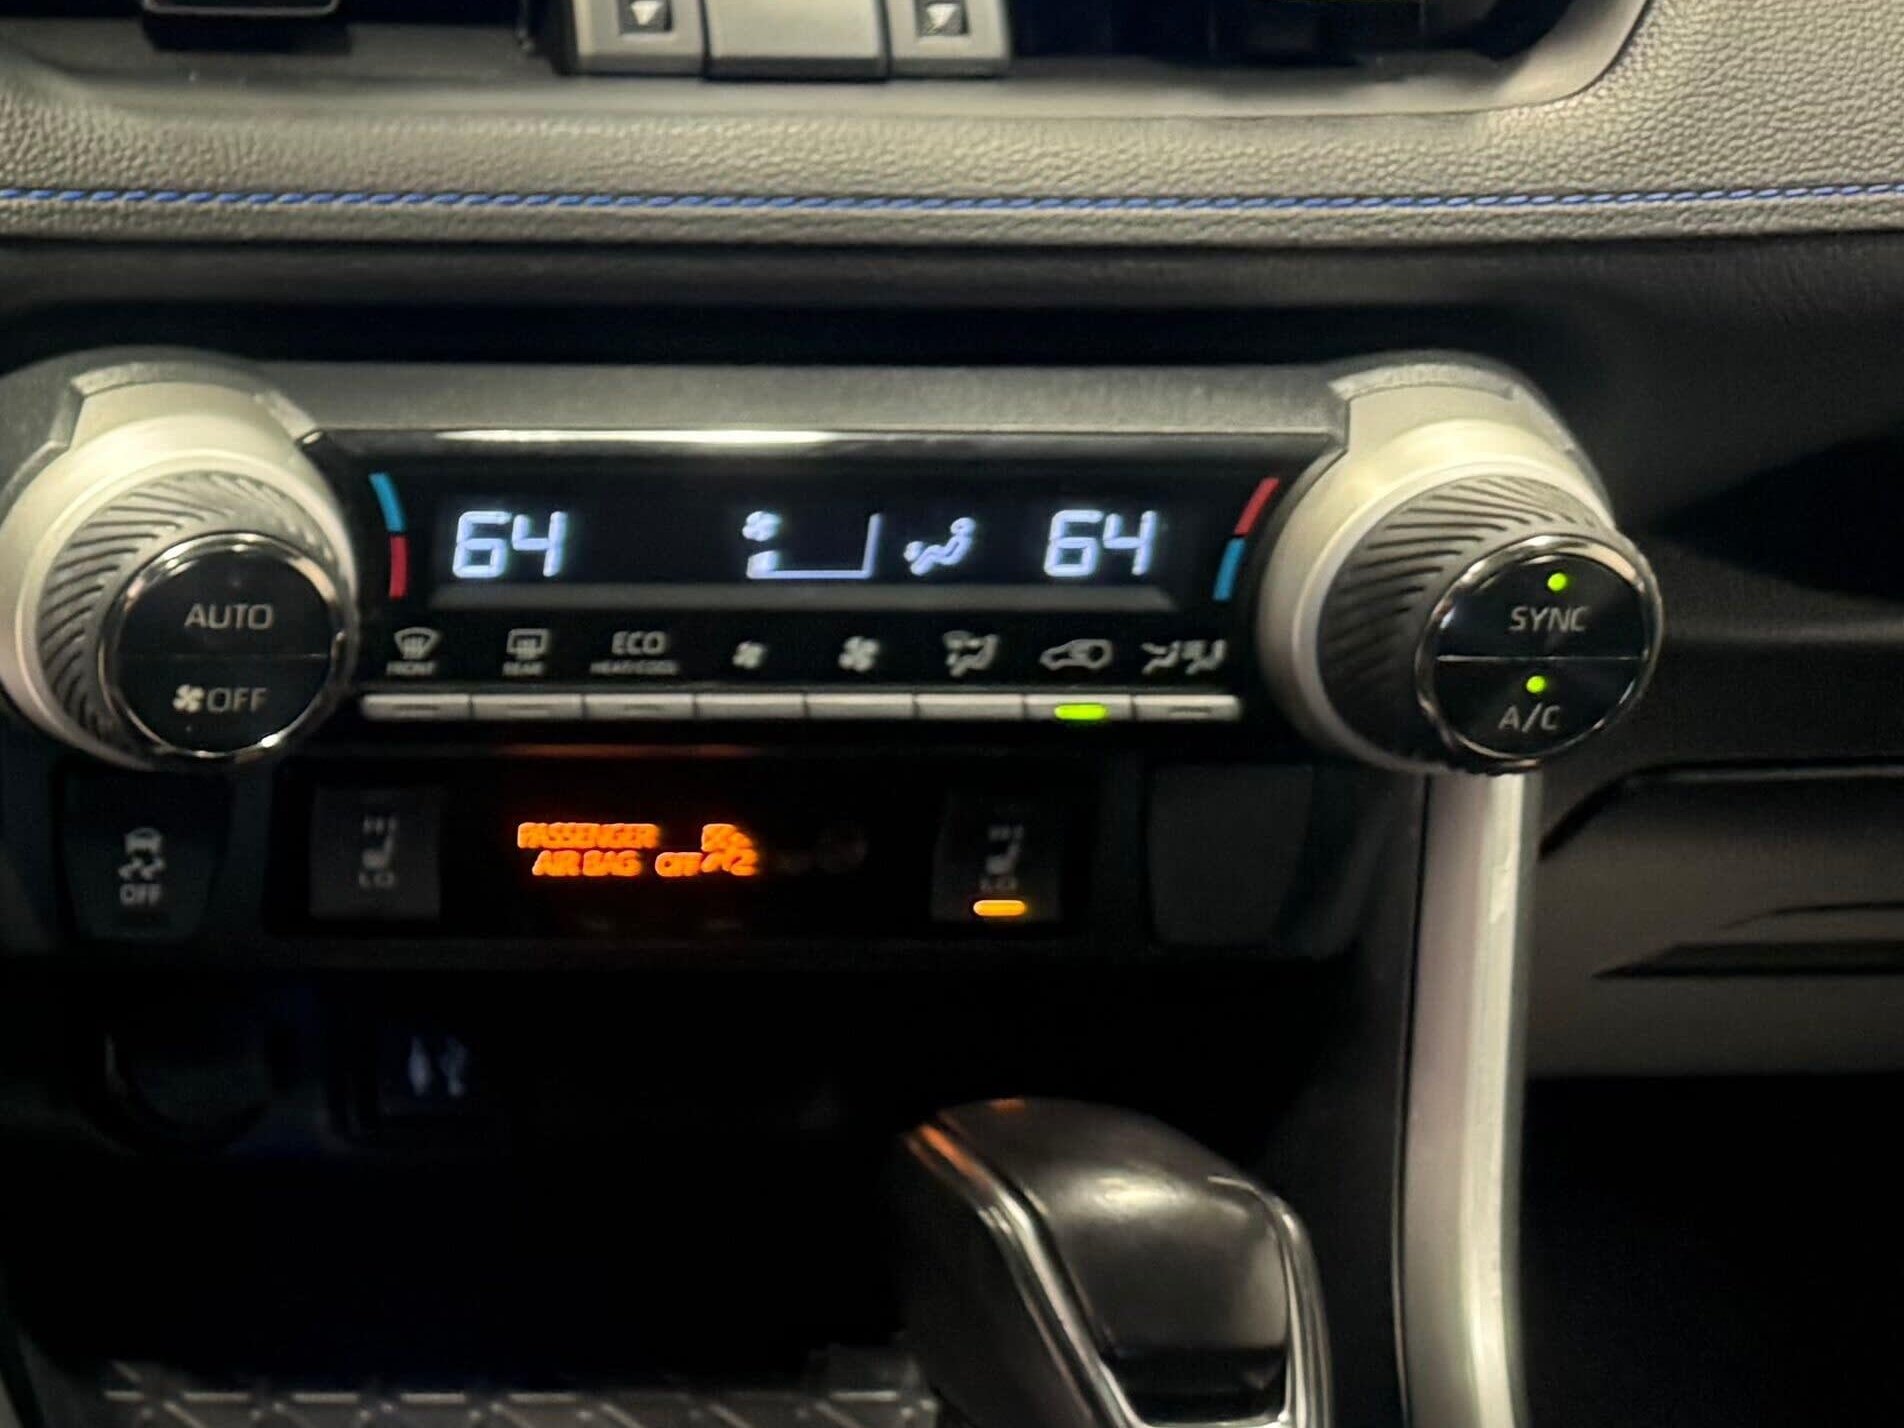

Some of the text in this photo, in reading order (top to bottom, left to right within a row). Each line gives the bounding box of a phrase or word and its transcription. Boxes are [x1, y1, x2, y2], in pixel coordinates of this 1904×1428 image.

[452, 510, 569, 579] 64
[1043, 510, 1158, 578] 64
[184, 603, 274, 632] AUTO
[1509, 605, 1588, 635] SYNC
[611, 629, 667, 656] ECO
[207, 686, 267, 714] OFF
[1497, 703, 1563, 735] A/C
[119, 882, 162, 906] OFF
